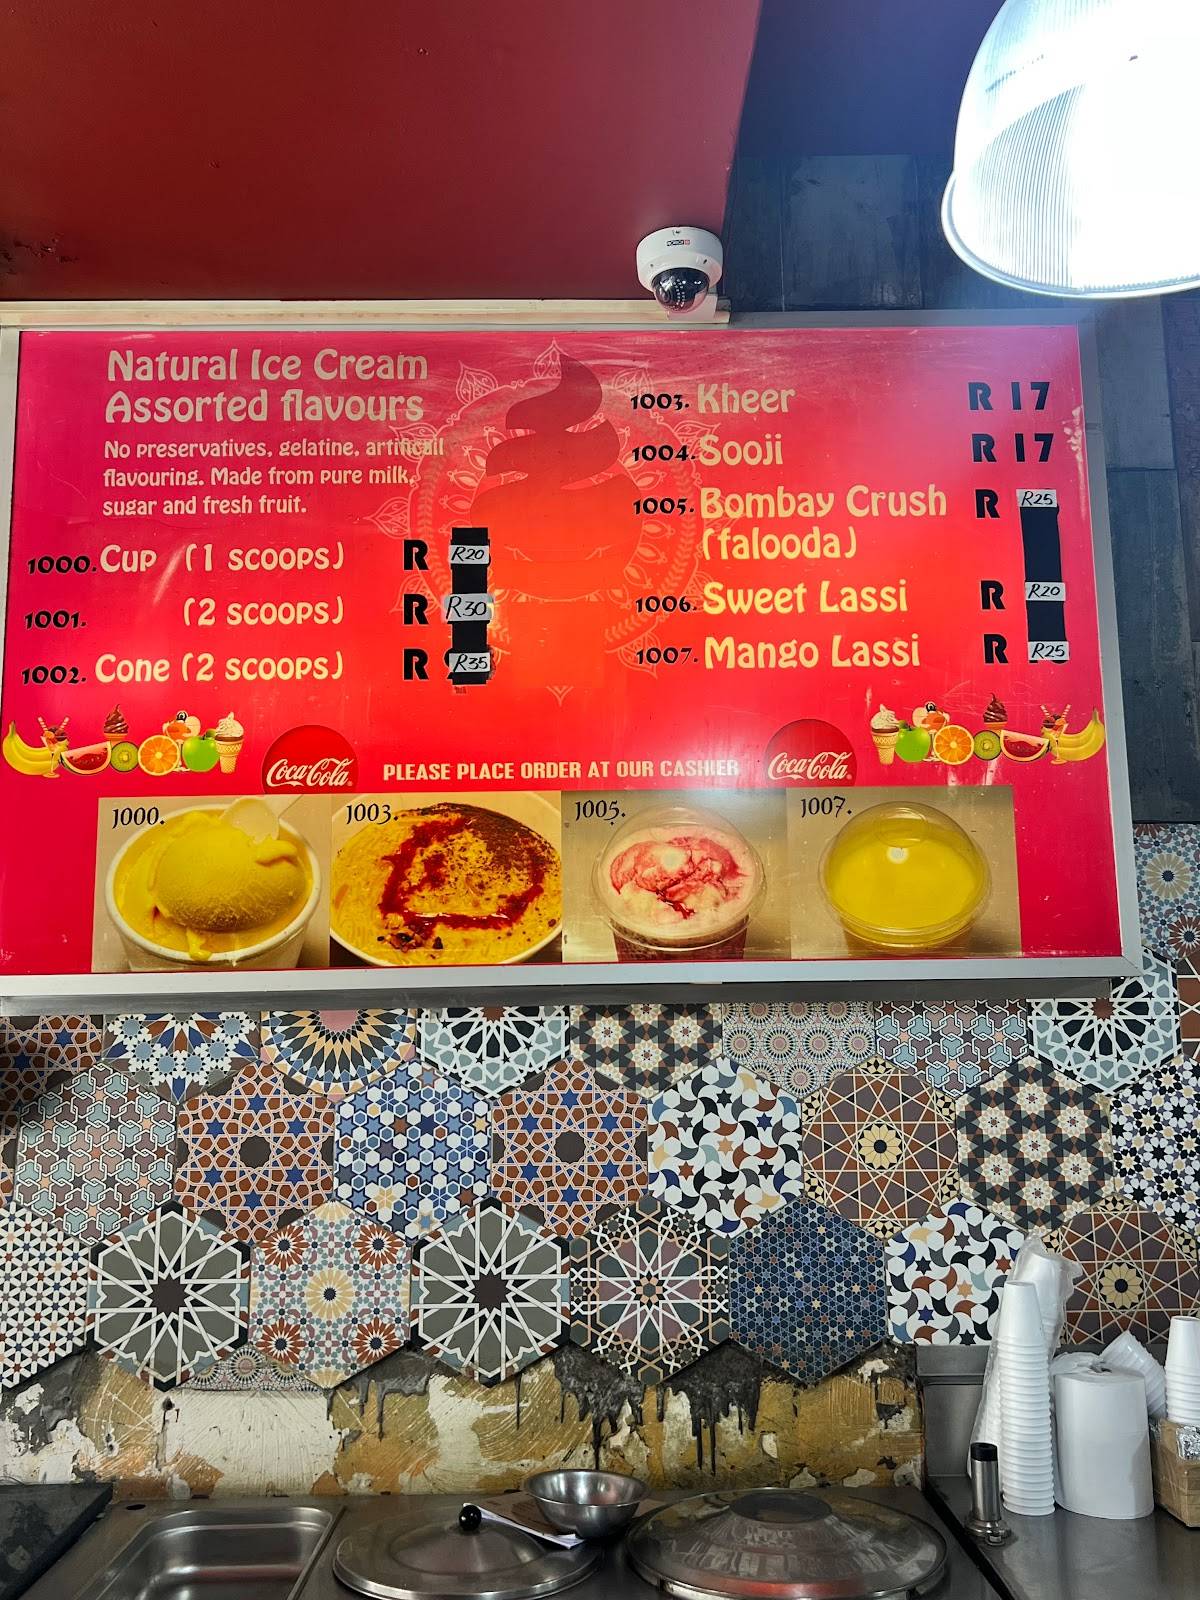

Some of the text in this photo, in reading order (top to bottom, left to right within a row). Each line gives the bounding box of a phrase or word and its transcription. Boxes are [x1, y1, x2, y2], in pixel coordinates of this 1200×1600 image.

[107, 348, 428, 382] Natural Ice Cream
[105, 388, 424, 424] Assorted flavours
[630, 382, 1050, 414] 1003. Kheer R 17
[104, 440, 131, 459] No
[136, 438, 272, 458] preservatives,
[631, 433, 1054, 466] 1004. Sooji R 17
[103, 467, 204, 487] flavouring.
[210, 467, 262, 486] Made
[268, 467, 314, 485] from
[320, 468, 363, 485] pure
[102, 495, 307, 516] sugar and fresh fruit.
[633, 484, 1000, 519] 1005. Bombay Crush R
[1021, 490, 1053, 507] R25
[27, 539, 429, 575] 1000. Cup (1 scoops) R
[451, 546, 485, 562] R20
[702, 526, 857, 560] (falooda)
[635, 579, 1006, 615] 1006. Sweet Lassi R
[1028, 583, 1061, 599] R20
[24, 593, 429, 629] 1001. (2 scoops) R
[446, 595, 487, 620] R30
[21, 648, 429, 684] 1002. Cone (2 scoops) R
[453, 653, 488, 673] R35
[636, 633, 1009, 669] 1007. Mango Lassi R
[1031, 642, 1066, 659] R25
[383, 759, 739, 781] PLEASE PLACE ORDER AT OUR CASHIER
